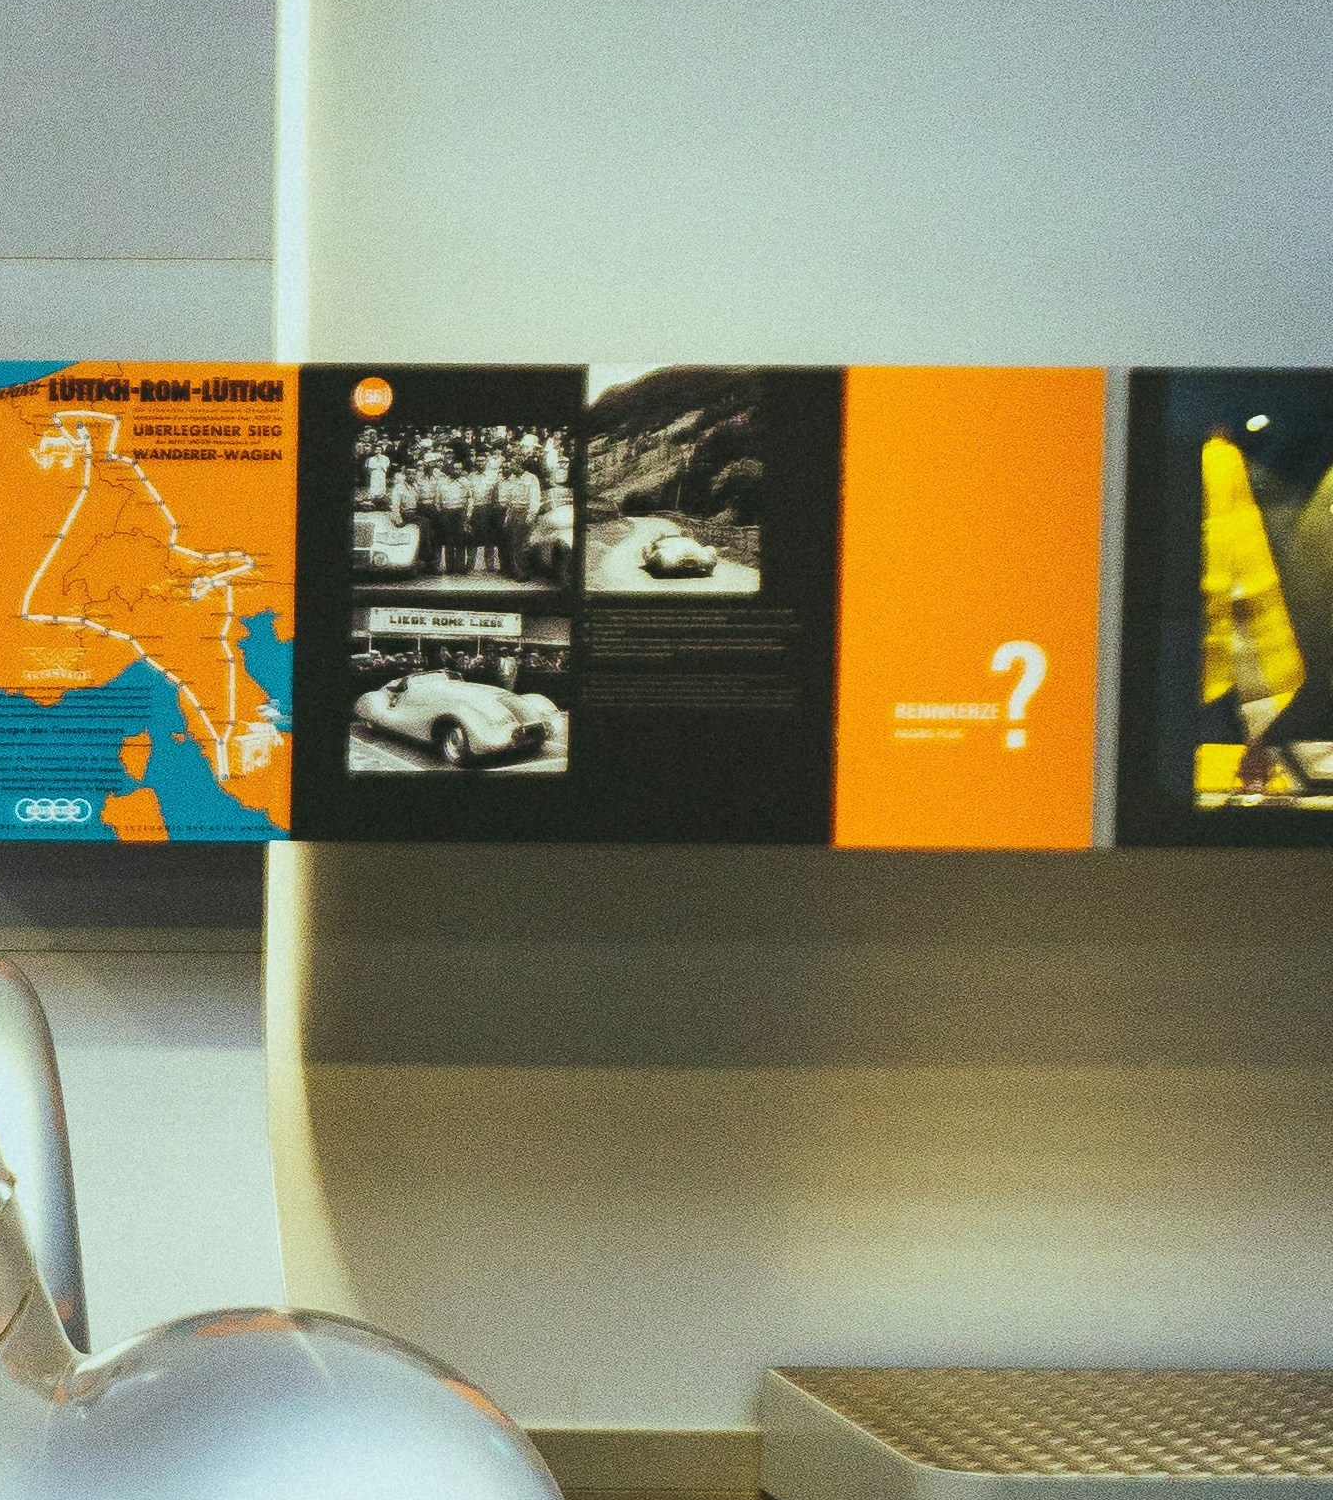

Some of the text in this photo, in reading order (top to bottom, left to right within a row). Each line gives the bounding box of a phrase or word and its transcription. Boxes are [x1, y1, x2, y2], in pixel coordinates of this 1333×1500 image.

[48, 376, 284, 402] LÜTTICH-ROM-LÜTTICH
[247, 423, 283, 437] SIEG
[133, 448, 283, 461] WANDERER-WAGEN
